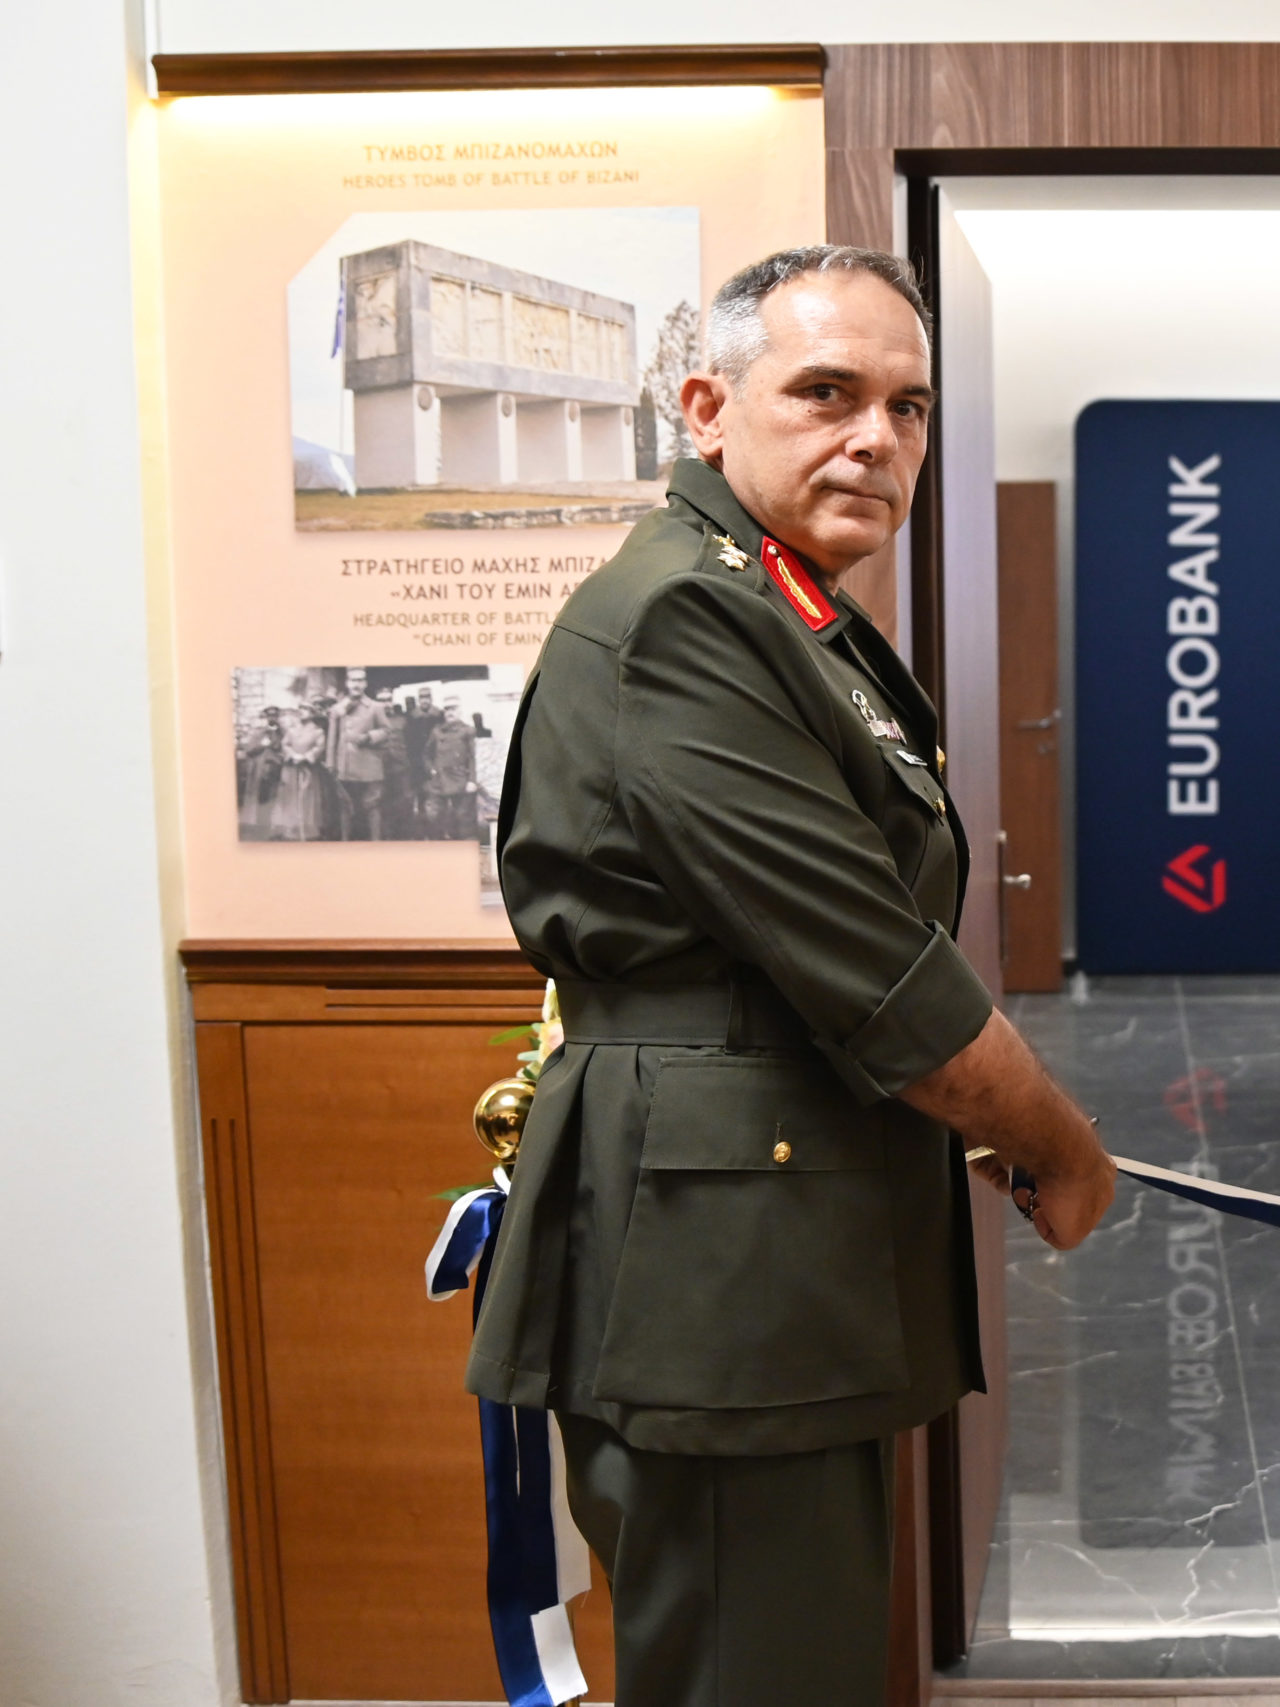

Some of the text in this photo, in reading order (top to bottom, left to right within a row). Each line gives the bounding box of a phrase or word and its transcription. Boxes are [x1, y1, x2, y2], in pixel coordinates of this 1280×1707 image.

[364, 141, 619, 163] ΤΥΜΒΟΣ ΜΠΙΖΑΝΟΜΑΧΩΝ
[343, 169, 640, 189] HEROES TOMB OF BATTLE OF BIZANI
[341, 556, 608, 576] ΣΤΡΑΤΗΓΕΙΟ ΜΑΧΗΣ ΜΠΙΖ
[391, 584, 449, 600] «ΧΑΝΙ
[456, 583, 497, 600] ΤΟΥ
[504, 582, 551, 599] ΕΜΙΝ
[353, 611, 560, 629] HEADQUARTER OF BATTL
[477, 632, 498, 646] OF
[505, 632, 542, 646] EMIN
[1167, 453, 1221, 814] EUROBANK
